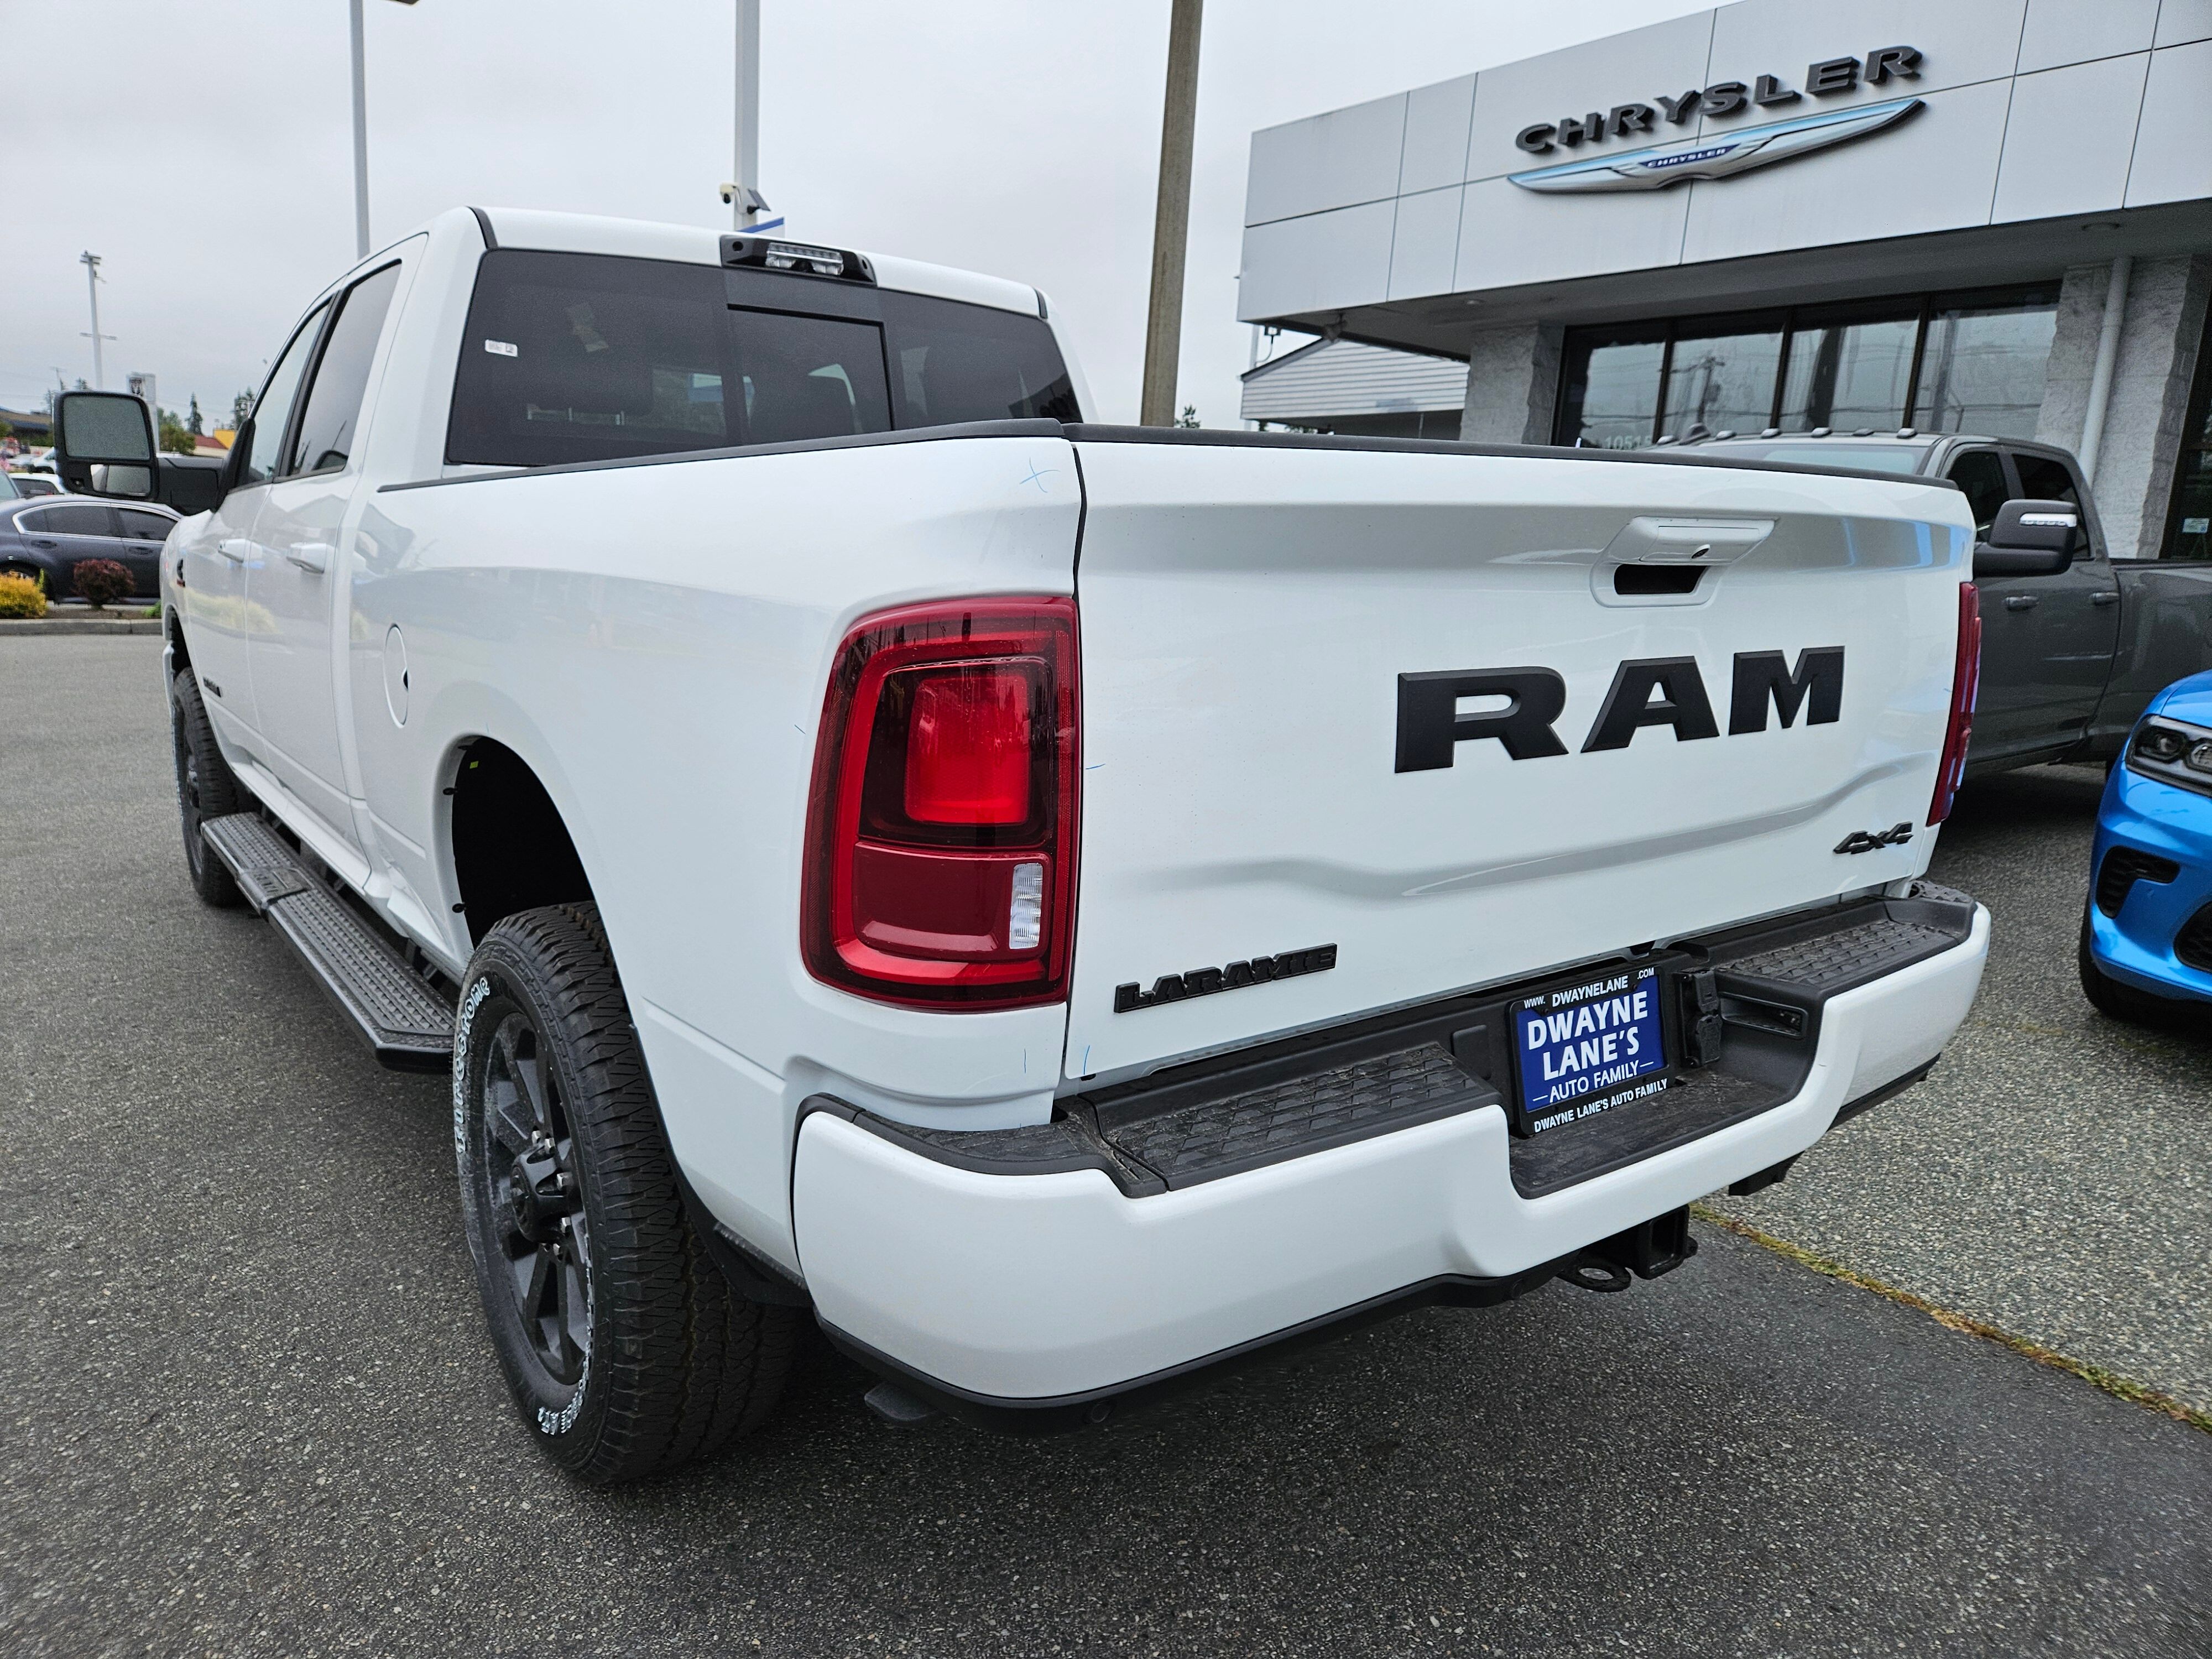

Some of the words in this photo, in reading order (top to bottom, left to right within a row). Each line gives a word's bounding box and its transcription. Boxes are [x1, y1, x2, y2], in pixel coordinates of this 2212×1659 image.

[1516, 45, 1923, 153] CHRYSLER
[1647, 148, 1726, 168] CHRYSLER
[1394, 645, 1845, 774] RAM
[1113, 942, 1338, 1014] LARAMIE
[1552, 975, 1628, 1007] DWAYNELANE
[1637, 967, 1654, 980] .COM
[1527, 991, 1648, 1050] DWAYNE
[1543, 1026, 1640, 1081] LANE'S
[1534, 1110, 1574, 1133] DWAYNE
[1577, 1098, 1609, 1118] LANE'S
[1610, 1090, 1634, 1107] AUTO
[1635, 1078, 1668, 1099] FAMILY
[1550, 1076, 1589, 1103] AUTO
[1593, 1060, 1640, 1088] FAMILY
